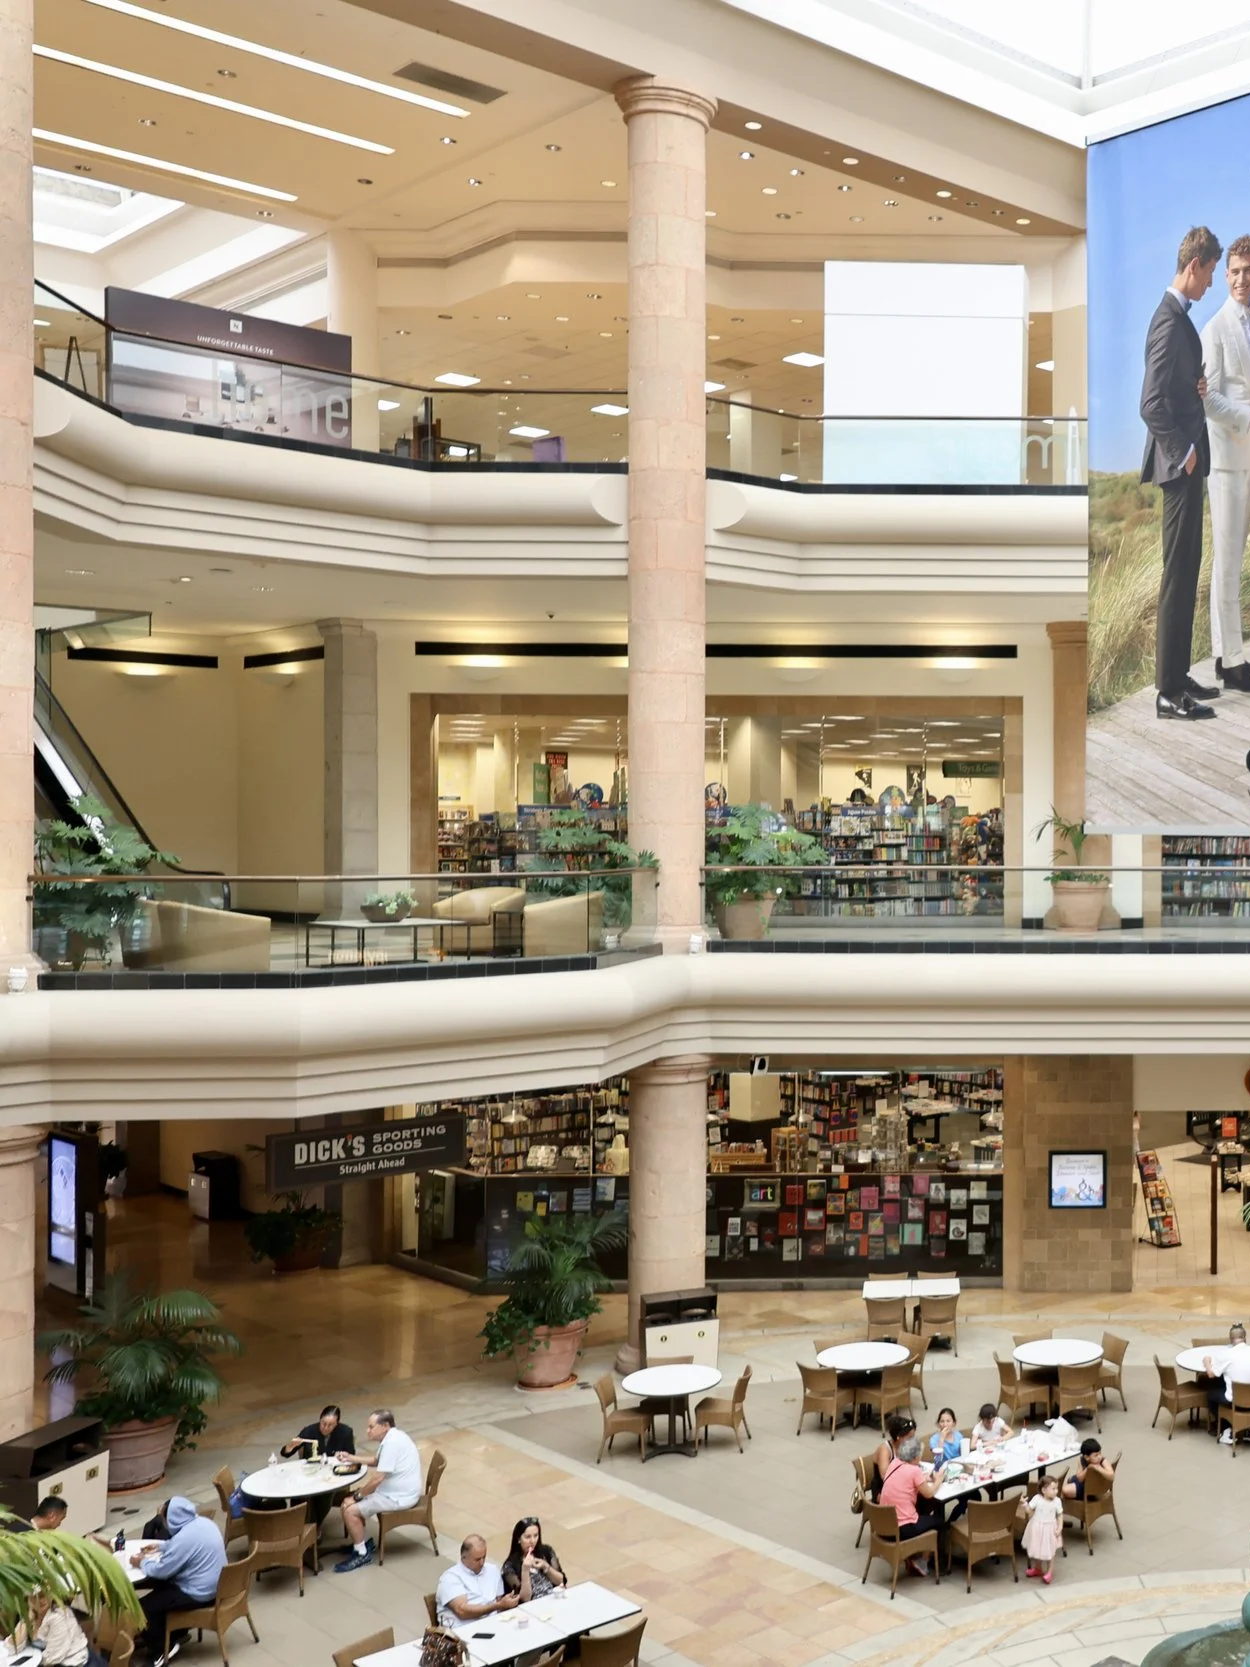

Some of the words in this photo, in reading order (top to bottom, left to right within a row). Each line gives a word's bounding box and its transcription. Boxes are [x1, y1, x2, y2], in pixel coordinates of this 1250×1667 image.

[196, 335, 253, 352] UNFORGETTABLE
[255, 345, 274, 356] TASTE
[294, 1134, 366, 1165] DICK'S
[372, 1124, 447, 1143] SPORTING
[372, 1139, 422, 1154] GOODS
[339, 1160, 376, 1175] Straight
[377, 1157, 405, 1171] Ahead
[751, 1186, 773, 1200] art
